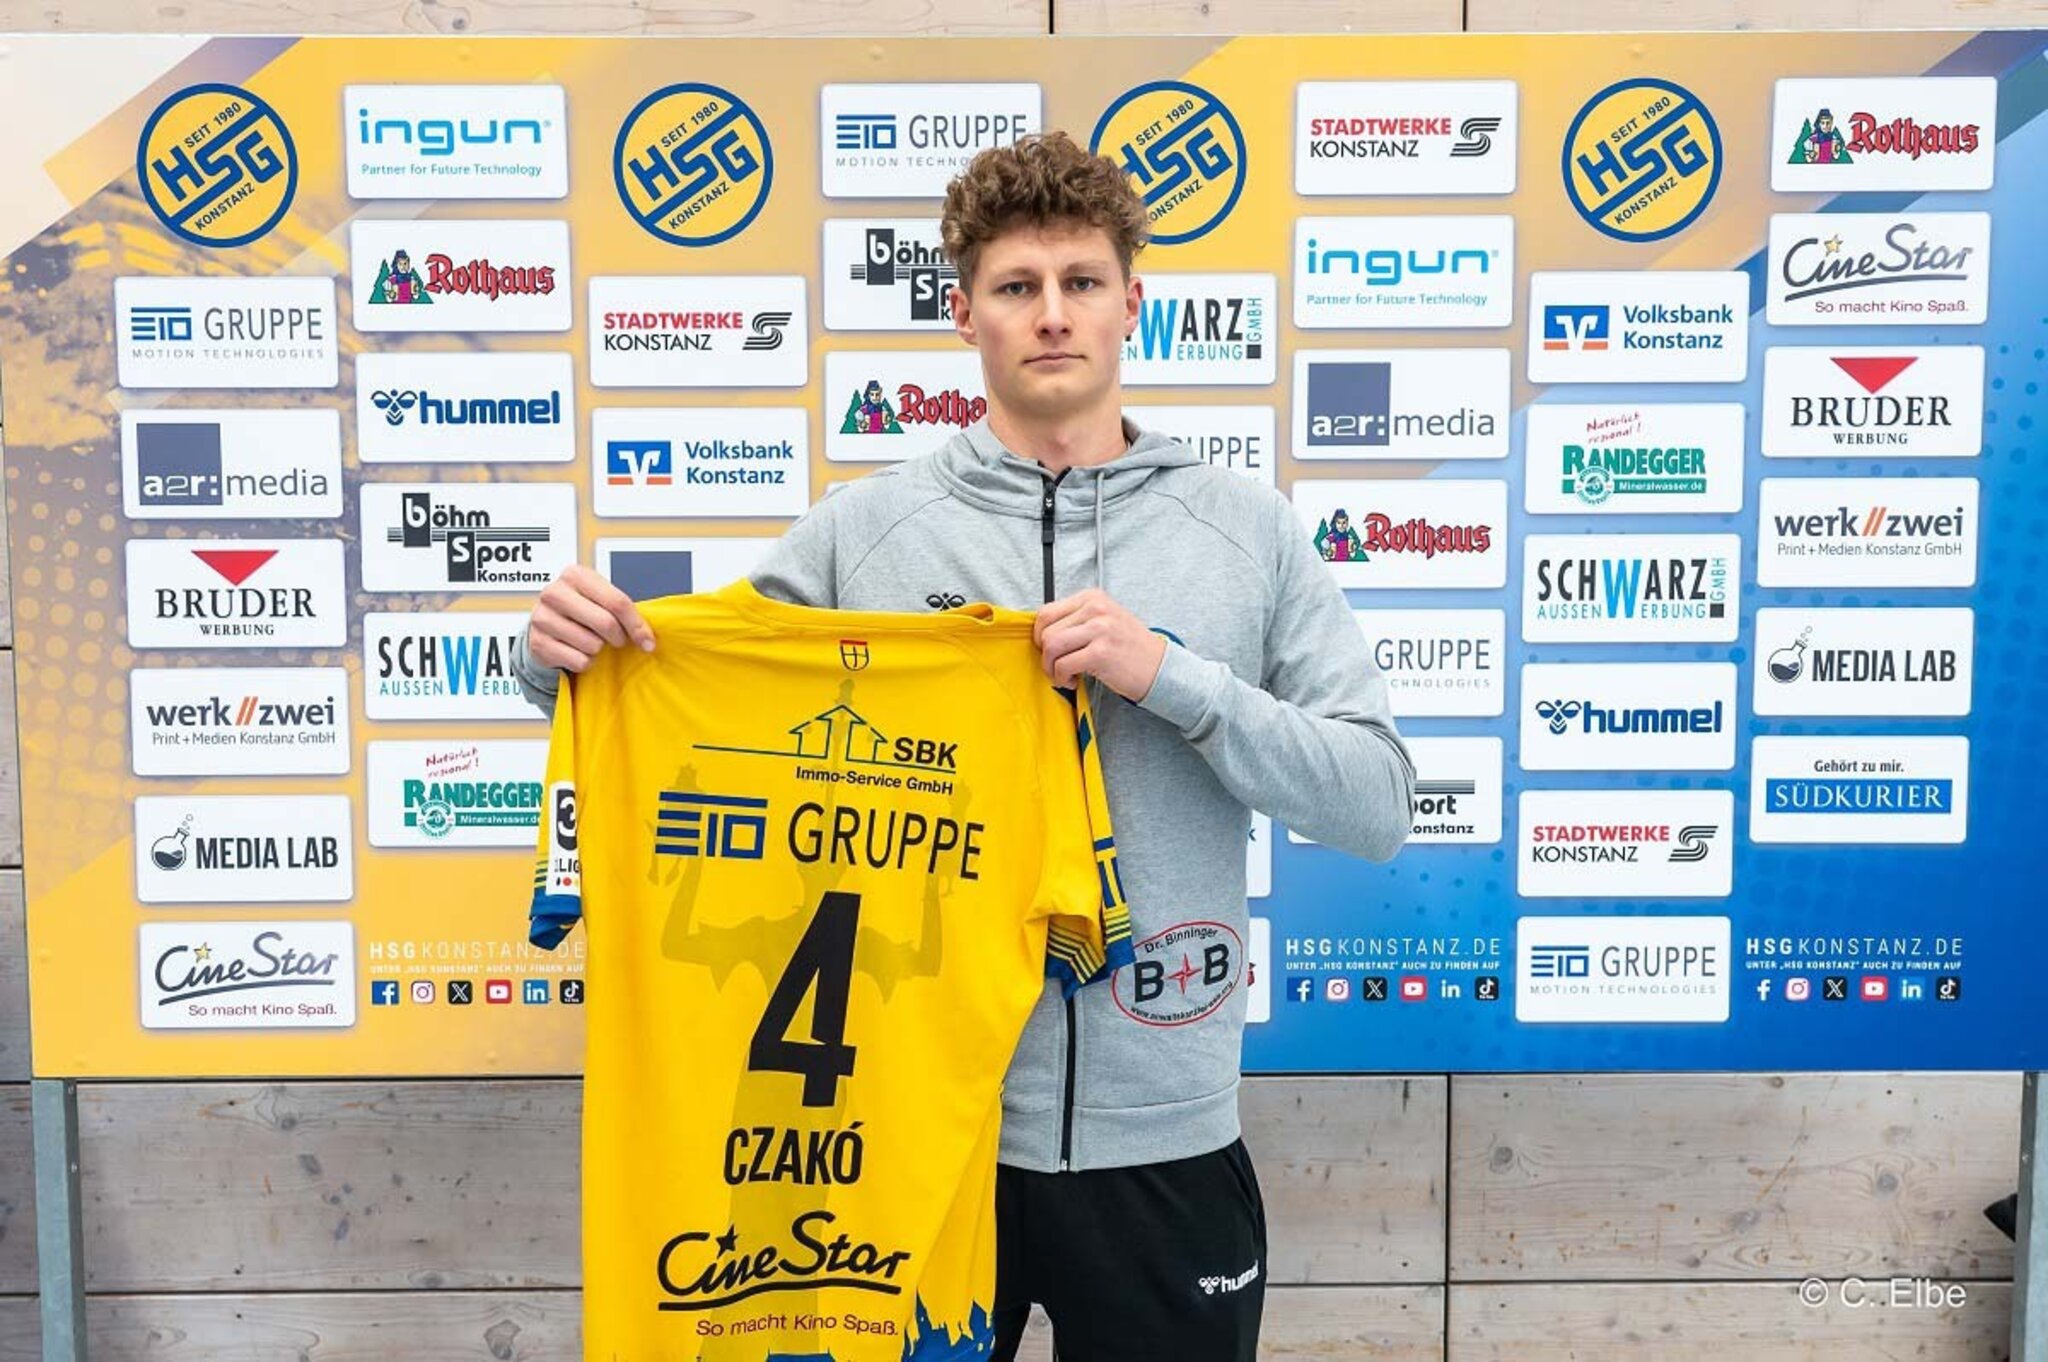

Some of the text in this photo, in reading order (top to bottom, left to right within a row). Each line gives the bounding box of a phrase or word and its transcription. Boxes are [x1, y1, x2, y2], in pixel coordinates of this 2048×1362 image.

[184, 102, 242, 148] SEIT 1980
[661, 101, 719, 148] SEIT 1980
[1136, 100, 1194, 146] SEIT 1980
[1310, 117, 1452, 135] STADTWERKE
[1611, 96, 1671, 143] SEIT 1980
[1310, 140, 1419, 158] KONSTANZ
[1848, 112, 1980, 161] Rothaus
[152, 130, 284, 201] HSG
[361, 162, 542, 177] Partner for Future Technology
[628, 129, 760, 201] HSG
[836, 157, 971, 166] MOTION TECHNO
[1577, 124, 1709, 196] HSG
[195, 182, 255, 231] KONSTANZ
[668, 181, 730, 230] KONSTANZ
[1148, 179, 1203, 223] ONSTANZ
[1614, 176, 1677, 225] KONSTANZ
[425, 253, 556, 302] Rothaus
[1306, 292, 1487, 307] Partner for Future Technology
[1623, 305, 1733, 324] Volksbank
[1815, 300, 1969, 316] So macht Kino Spaß.
[204, 307, 324, 341] GRUPPE
[603, 312, 743, 330] STADTWERKE
[1138, 298, 1243, 360] WARZ
[132, 348, 324, 359] MOTION TECHNOLOGIES
[604, 334, 713, 351] KONSTANZ
[1623, 331, 1724, 350] Konstanz
[419, 390, 561, 425] hummel
[897, 383, 987, 429] Rotha
[1791, 397, 1952, 427] BRUDER
[685, 441, 793, 460] Volksbank
[1834, 433, 1908, 445] WERBUNG
[1563, 445, 1706, 475] RANDEGGER
[686, 467, 785, 485] Konstanz
[405, 497, 491, 528] böhm
[1363, 512, 1492, 559] Rothaus
[1778, 543, 1806, 556] Print
[1819, 543, 1862, 556] Medien
[1866, 543, 1921, 556] Konstanz
[1925, 543, 1962, 556] GmbH
[451, 536, 532, 567] Sport
[477, 570, 551, 584] Konstanz
[1536, 558, 1707, 619] SCHWARZ
[1710, 558, 1726, 601] GMBH
[155, 588, 317, 619] BRUDER
[200, 624, 275, 636] WERBUNG
[378, 635, 516, 695] SCHWA
[1374, 639, 1490, 671] GRUPPE
[1812, 649, 1956, 682] MEDIA LAB
[1390, 678, 1490, 688] CHNOLOGIES
[1584, 700, 1722, 733] hummel
[152, 732, 181, 745] Print
[192, 732, 236, 745] Medien
[240, 732, 294, 745] Konstanz
[298, 732, 336, 745] GmbH
[893, 737, 959, 769] SBK
[795, 766, 954, 795] Immo-Service GmbH
[1814, 759, 1905, 773] Gehört zu mir.
[404, 779, 543, 808] RANDEGGER
[1775, 781, 1943, 808] SÜDKURIER
[788, 802, 985, 881] GRUPPE
[1409, 823, 1475, 834] onstanz
[1532, 825, 1670, 842] STADTWERKE
[195, 836, 338, 869] MEDIA LAB
[1532, 847, 1638, 864] KONSTANZ
[1145, 943, 1163, 953] Dr.
[1601, 945, 1717, 978] GRUPPE
[1286, 961, 1317, 971] UNTER
[1402, 961, 1427, 971] AUCH
[1430, 961, 1442, 971] ZU
[1445, 961, 1479, 971] FINDEN
[1482, 961, 1500, 971] AUF
[1746, 961, 1777, 971] UNTER
[1863, 961, 1888, 971] AUCH
[1891, 961, 1903, 971] ZU
[1906, 961, 1940, 971] FINDEN
[1943, 961, 1961, 971] AUF
[748, 890, 861, 1107] 4
[1530, 985, 1717, 995] MOTION TECHNOLOGIES
[188, 1003, 338, 1018] So macht Kino Spaß.
[723, 1121, 864, 1185] CZAKÓ
[657, 1210, 912, 1297] CineStar
[696, 1314, 898, 1336] So macht Kino Spaß.
